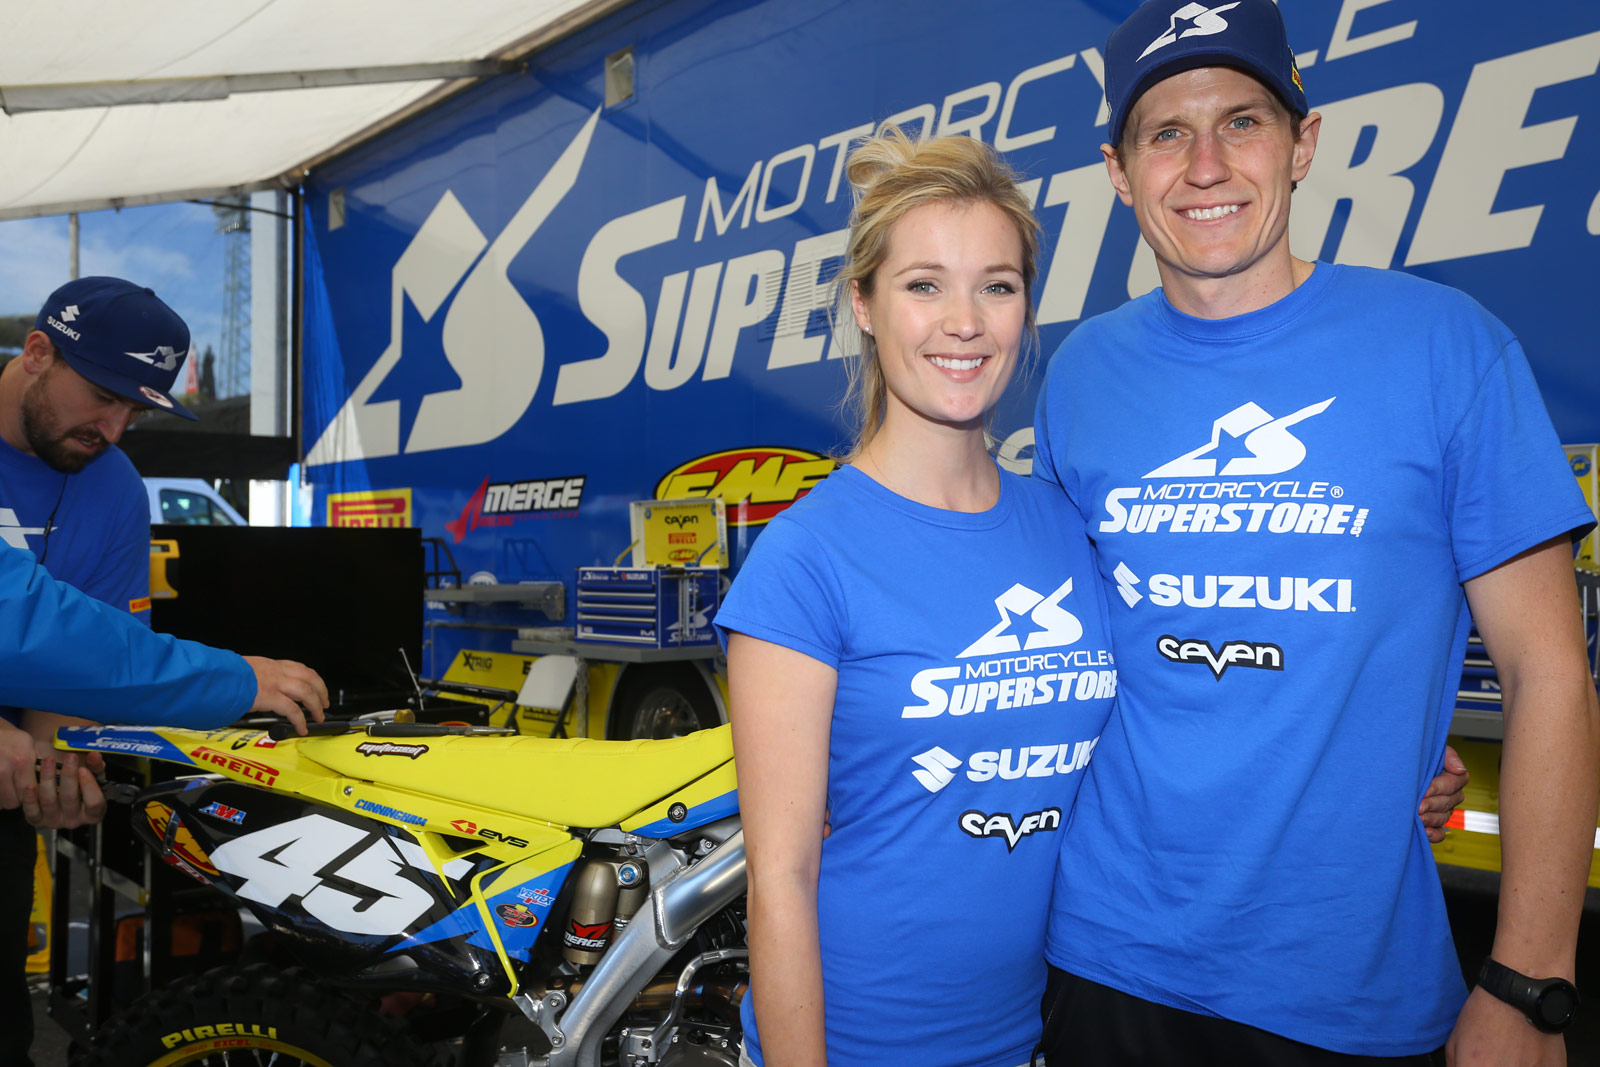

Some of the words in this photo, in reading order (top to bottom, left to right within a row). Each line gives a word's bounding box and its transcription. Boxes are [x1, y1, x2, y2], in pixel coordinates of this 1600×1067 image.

[46, 315, 81, 341] SUZUKI
[483, 478, 585, 513] MERGE
[191, 746, 280, 786] PIRELLI
[966, 736, 1100, 782] SUZUK
[199, 801, 247, 825] AMA
[354, 799, 428, 826] CUNNINGHAM
[209, 813, 475, 936] 45
[564, 930, 607, 948] MERGE
[160, 1023, 277, 1049] PIRELLI
